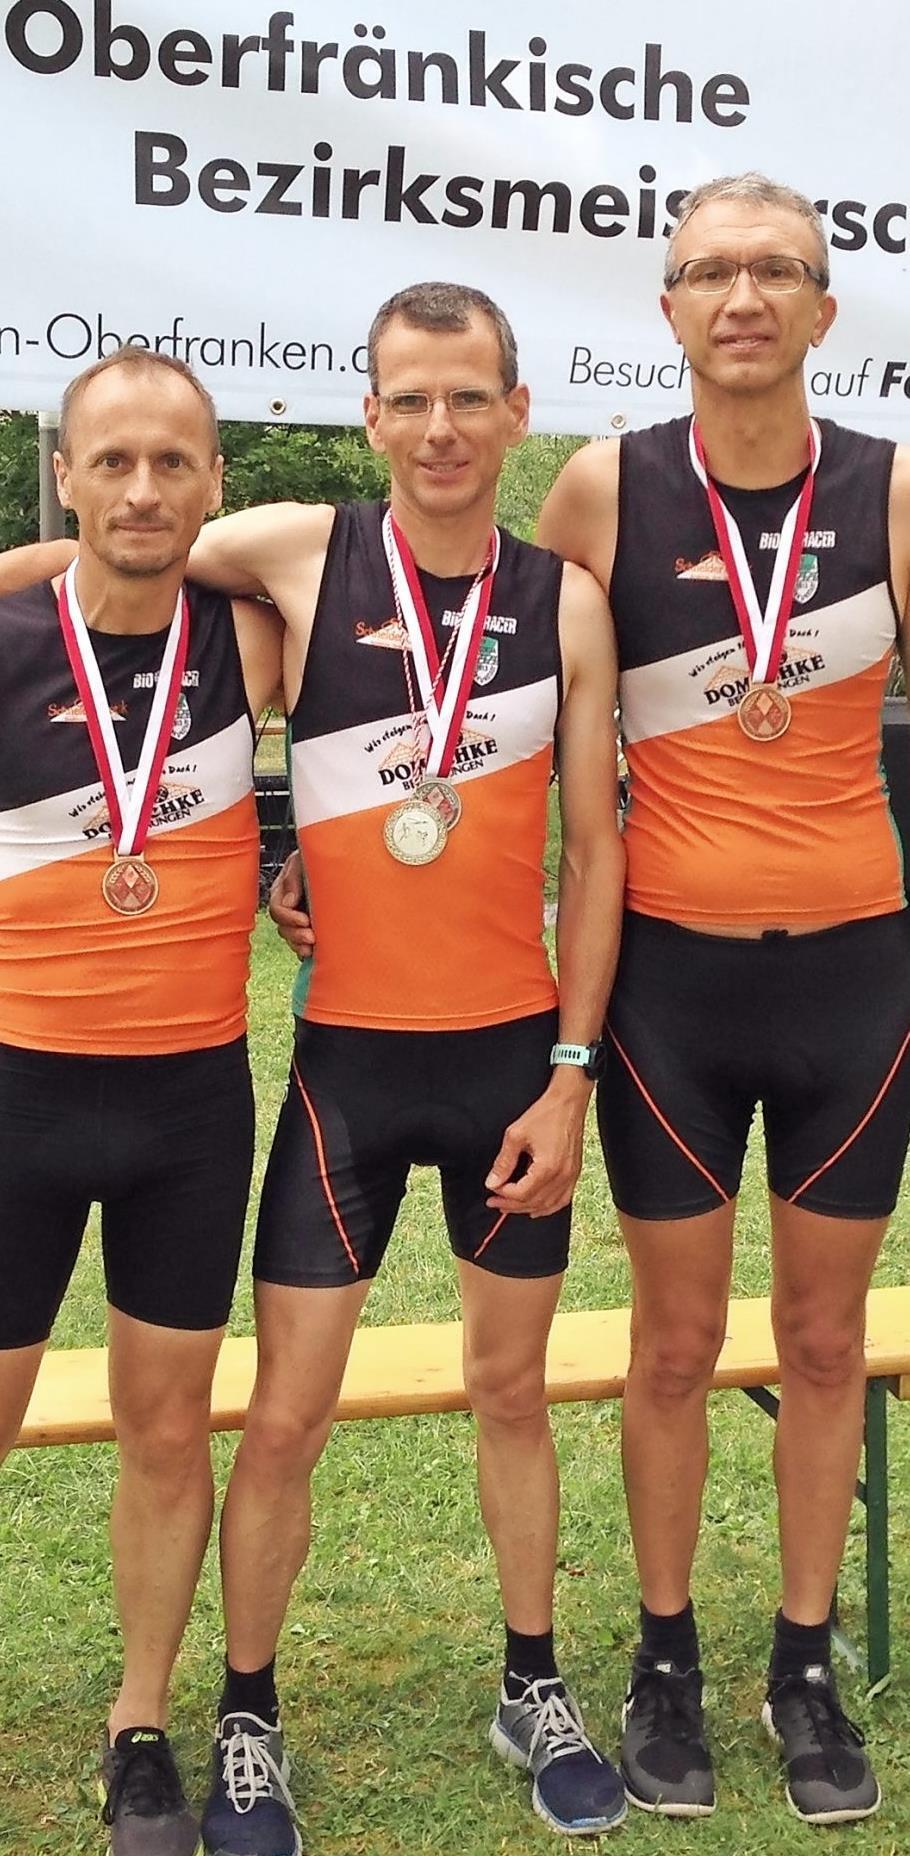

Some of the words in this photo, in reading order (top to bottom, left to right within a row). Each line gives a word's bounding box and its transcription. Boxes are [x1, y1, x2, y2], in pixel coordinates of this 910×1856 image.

[5, 0, 751, 127] Oberfränkische
[134, 130, 907, 254] Bezirksmeissc
[810, 358, 873, 397] auf
